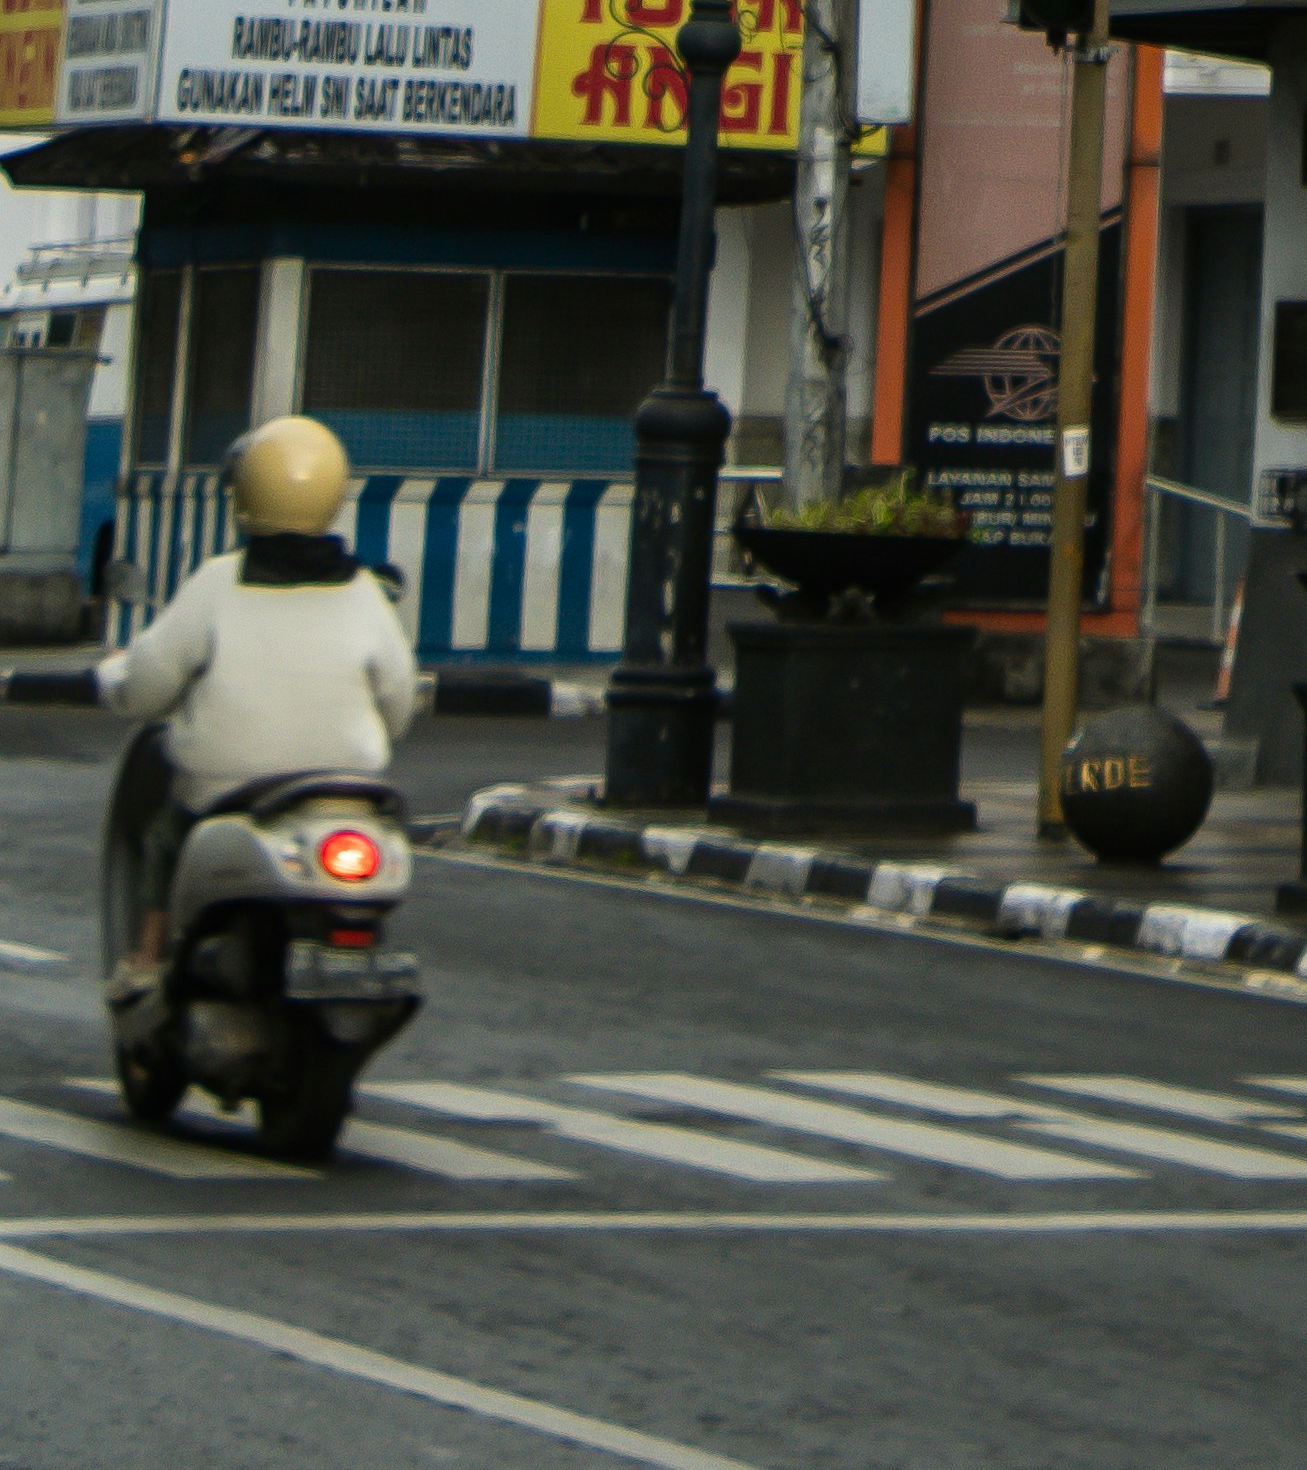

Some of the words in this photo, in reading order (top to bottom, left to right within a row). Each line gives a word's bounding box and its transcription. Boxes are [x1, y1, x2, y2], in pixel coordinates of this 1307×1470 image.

[231, 15, 361, 66] RAMBU-RAMBU
[363, 22, 411, 67] LALU
[412, 24, 475, 71] LINTAS
[176, 67, 265, 114] GUNAKAN
[267, 72, 319, 118] HELM
[319, 74, 352, 119] SNI
[353, 75, 399, 121] SAAT
[402, 78, 517, 127] BERKENDARA
[928, 425, 971, 444] POS
